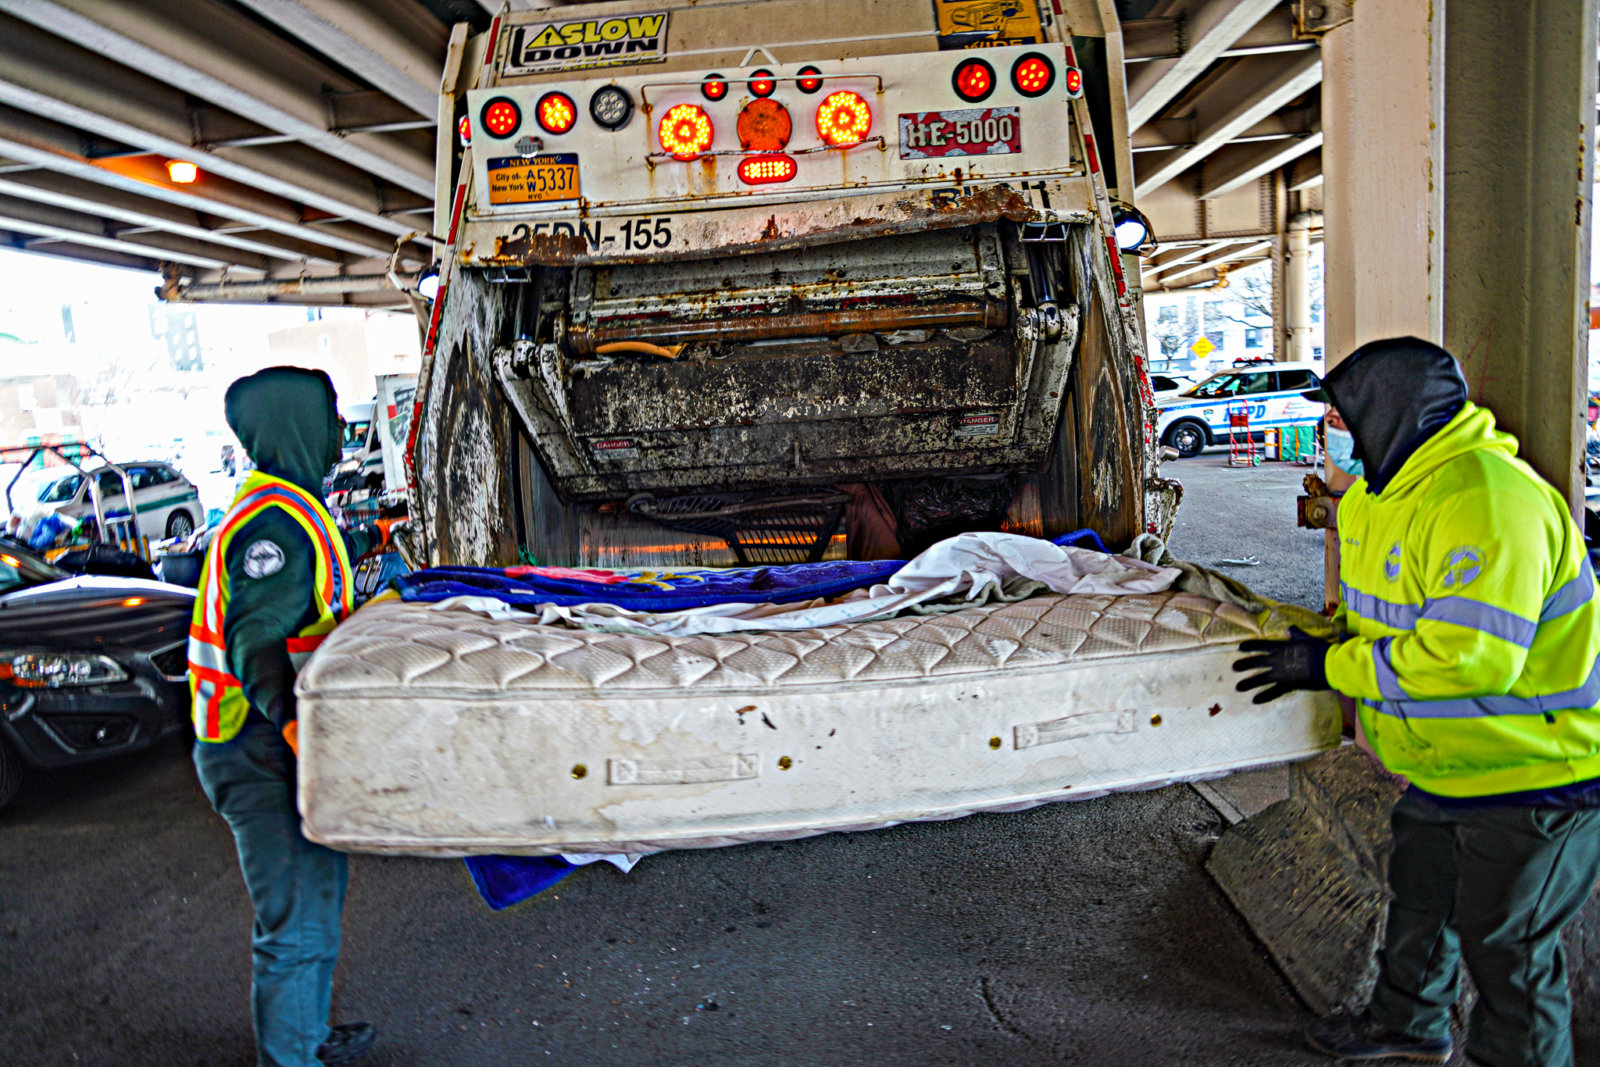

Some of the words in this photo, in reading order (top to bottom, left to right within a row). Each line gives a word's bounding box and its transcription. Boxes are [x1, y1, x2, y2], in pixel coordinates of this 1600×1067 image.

[559, 14, 665, 45] SLOW
[523, 38, 659, 63] DOWN
[907, 117, 1013, 147] HE-5000
[509, 157, 531, 167] NEW
[533, 156, 557, 166] YORK
[492, 184, 507, 192] New
[509, 183, 524, 191] York
[496, 173, 510, 182] City
[512, 172, 520, 180] of
[537, 166, 575, 192] 5337
